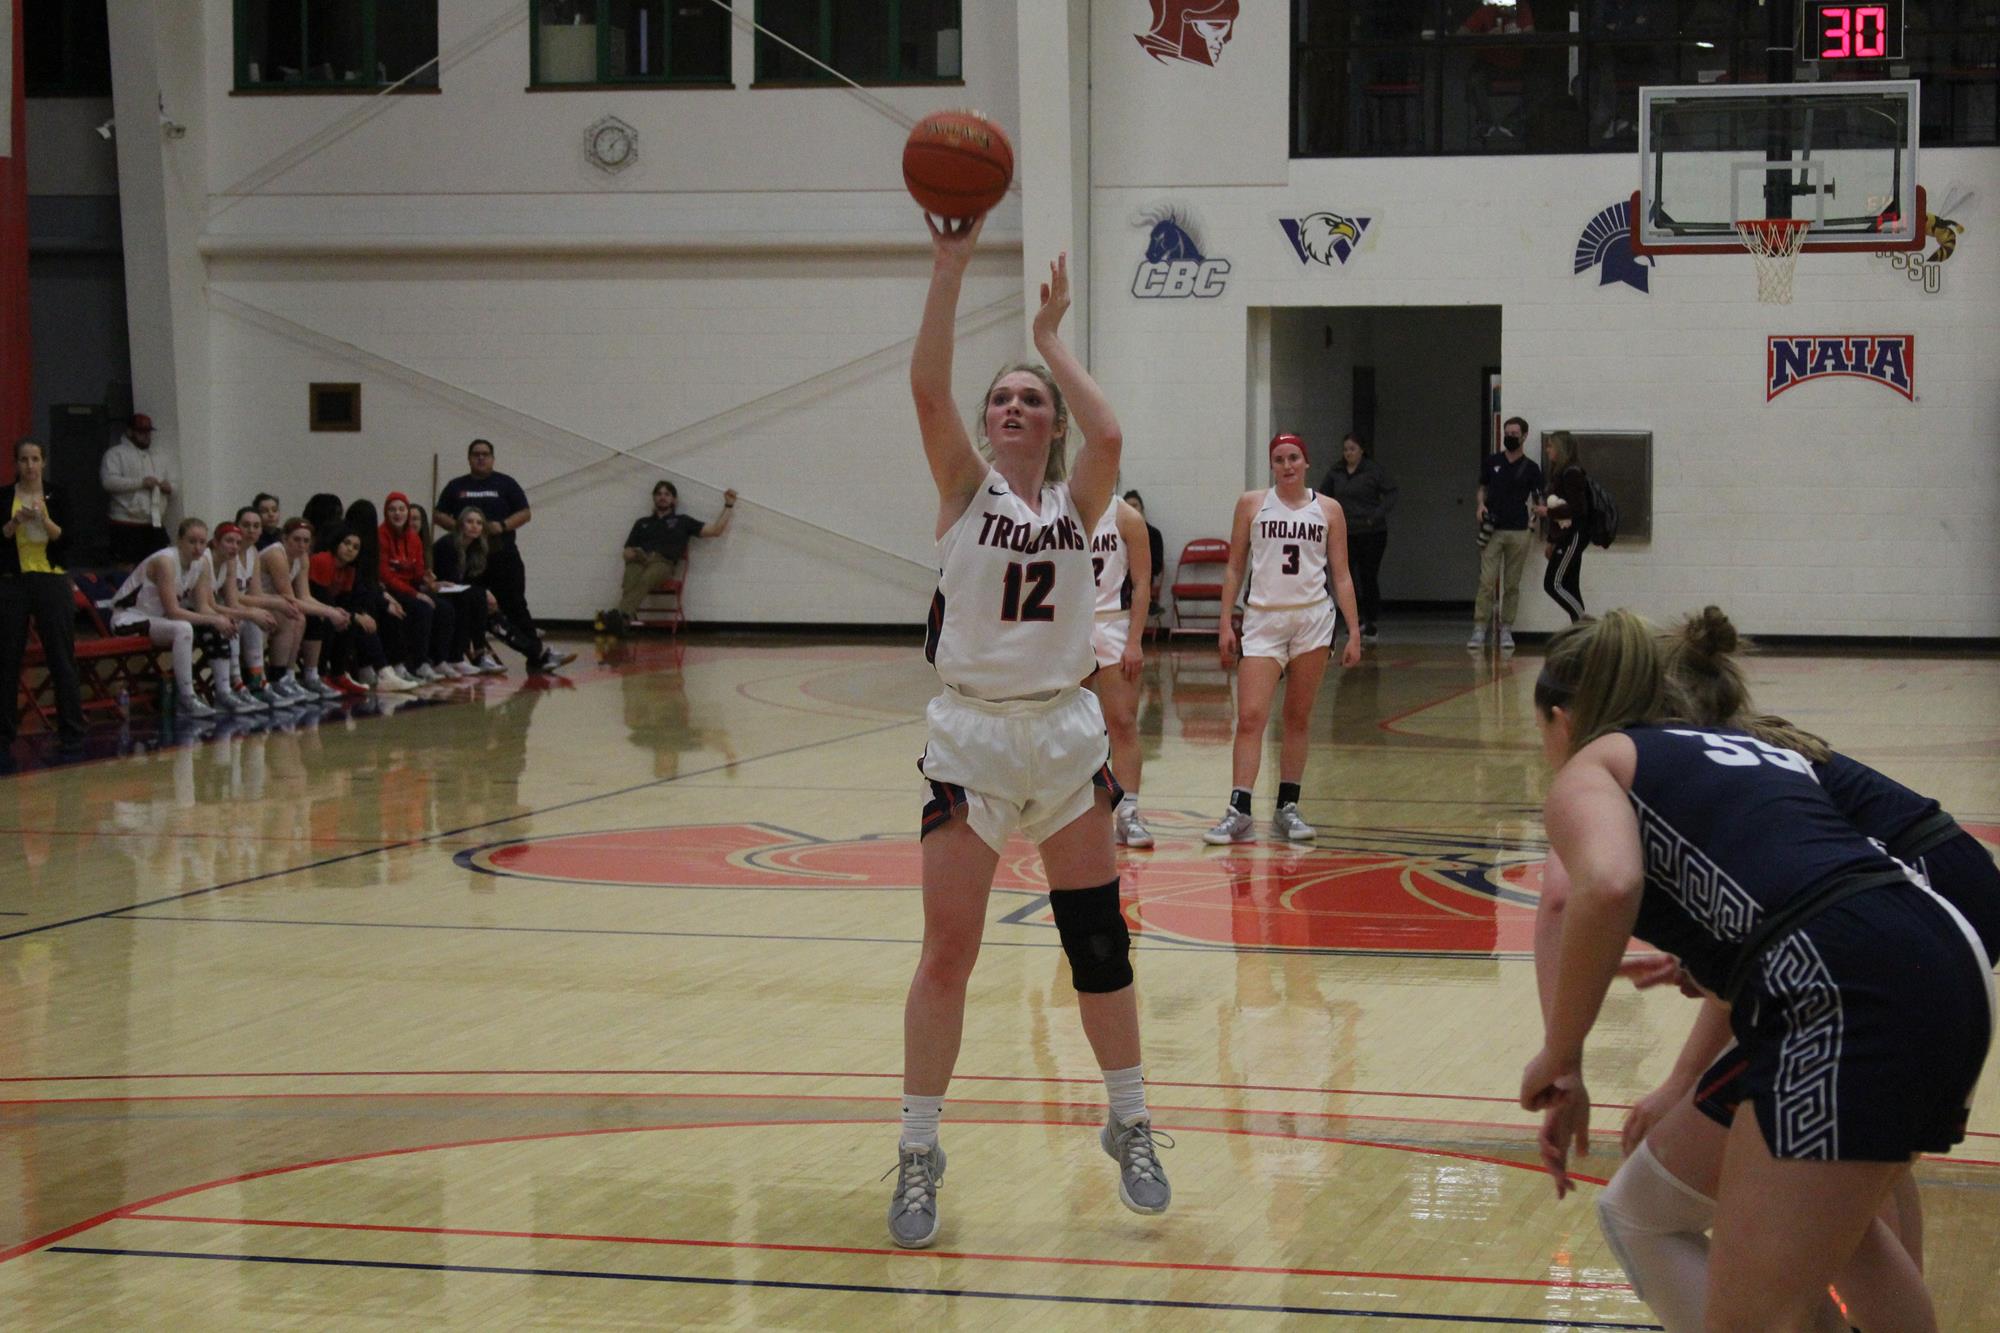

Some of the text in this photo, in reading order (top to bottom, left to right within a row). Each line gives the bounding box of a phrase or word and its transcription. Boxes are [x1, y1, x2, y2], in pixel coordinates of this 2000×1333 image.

[1822, 7, 1885, 57] 30
[1131, 258, 1231, 298] CBC
[1876, 250, 1940, 293] SSU
[1770, 338, 1911, 394] NAIA
[978, 511, 1084, 554] TROJANS
[1260, 520, 1324, 543] TROJANS
[1282, 544, 1300, 575] 3
[1001, 560, 1055, 622] 12
